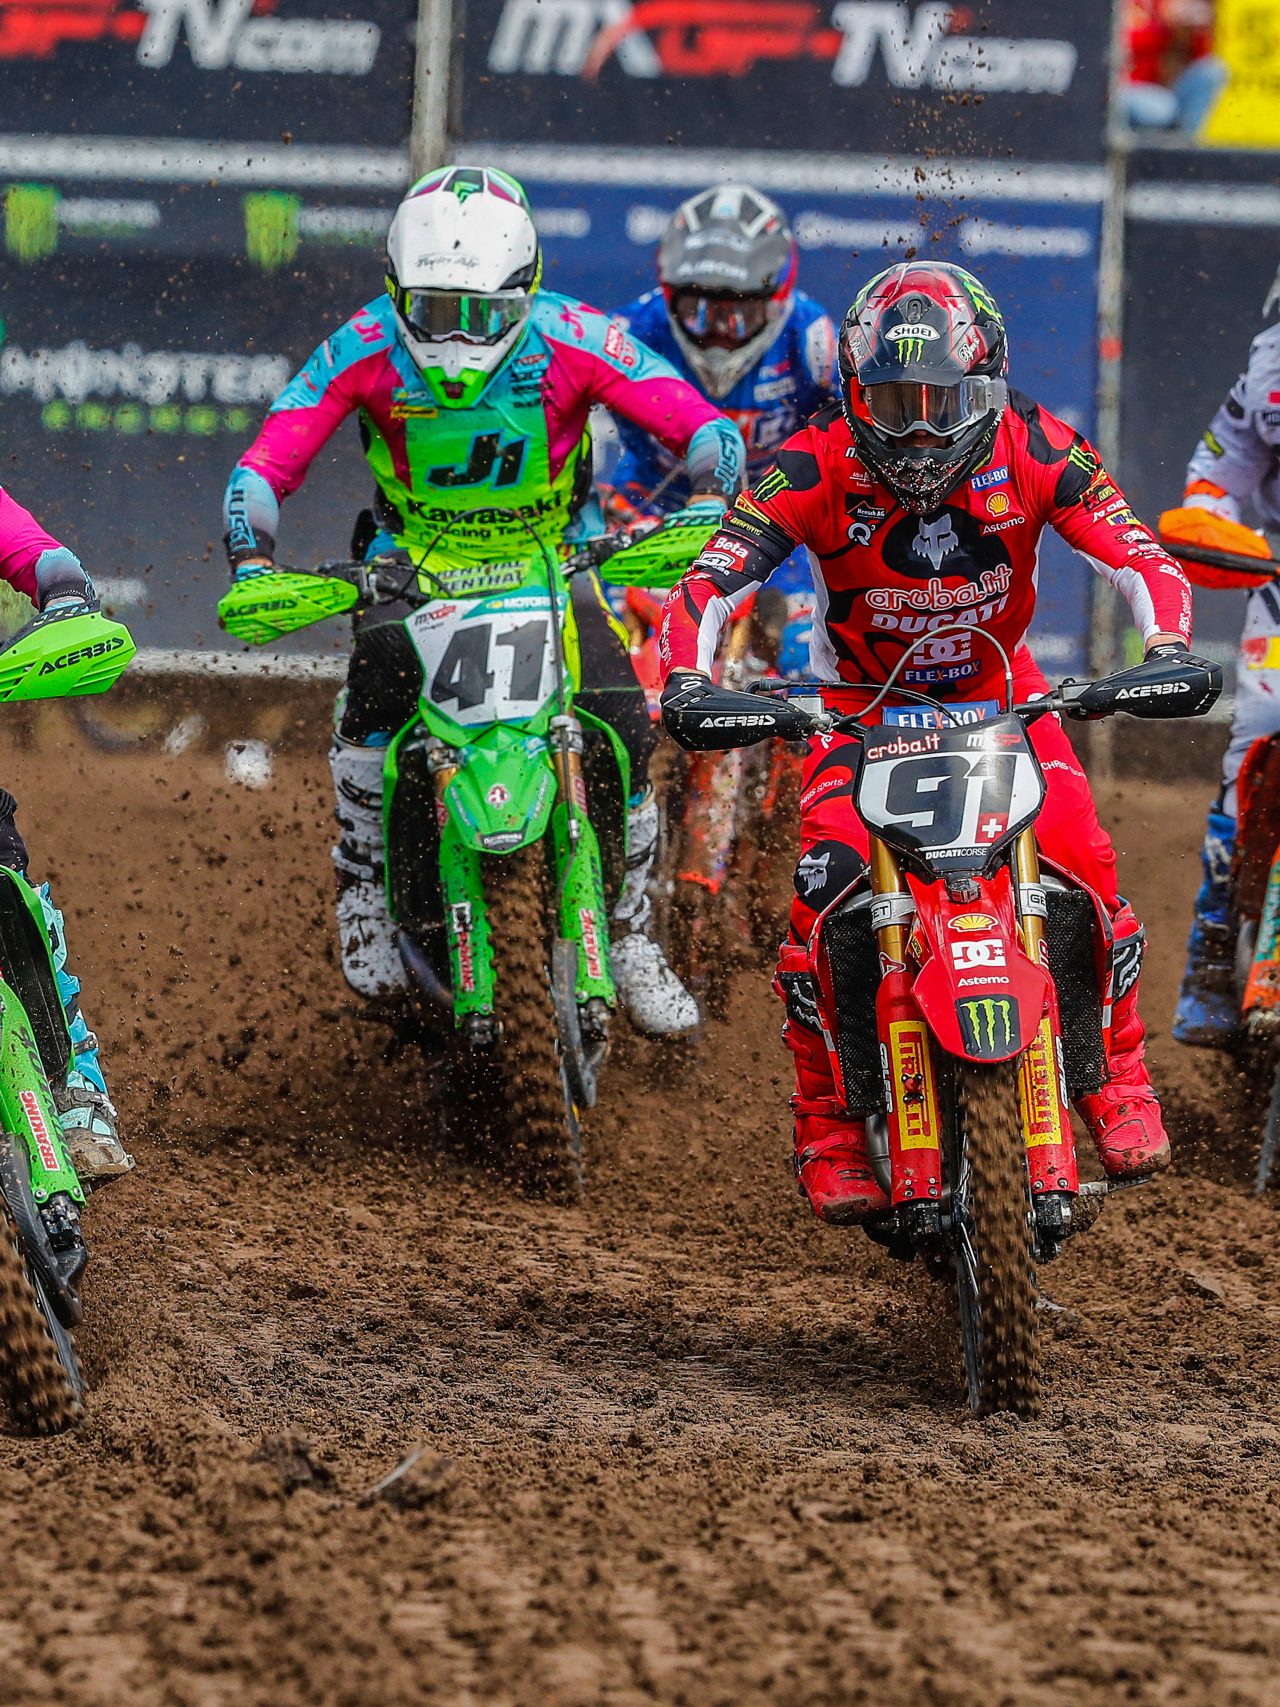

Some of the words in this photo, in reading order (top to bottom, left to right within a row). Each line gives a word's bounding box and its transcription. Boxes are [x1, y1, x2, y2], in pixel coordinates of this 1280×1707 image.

[893, 327, 933, 337] SHOEI
[971, 466, 1009, 489] FLEX-BO
[982, 516, 1025, 535] Astemo
[714, 536, 750, 559] Beta
[865, 563, 1013, 612] aruba.it
[871, 593, 1010, 633] DUCATI
[431, 619, 549, 712] 41
[904, 661, 981, 682] FLEX-BOX
[867, 733, 941, 760] aruba.it
[885, 754, 1018, 849] 91
[951, 938, 1007, 971] DC
[957, 975, 1010, 988] Astemo
[21, 1091, 58, 1171] BRAKING
